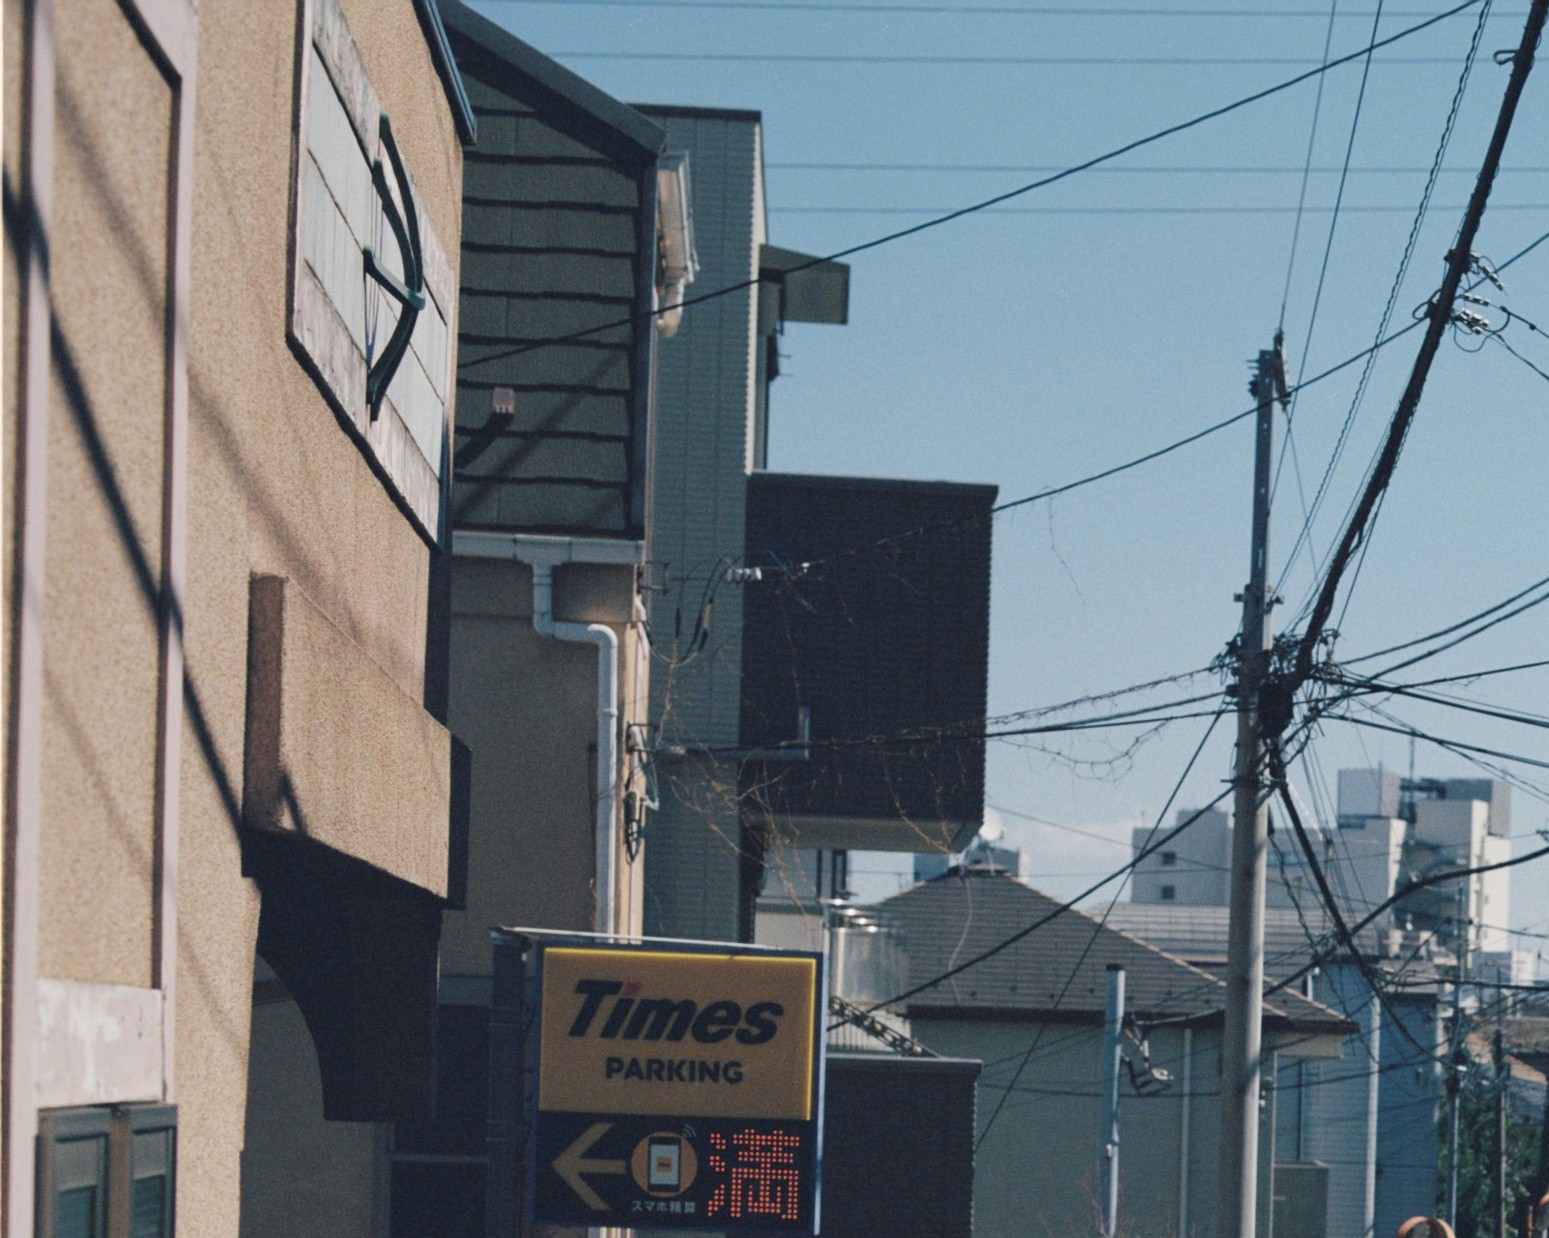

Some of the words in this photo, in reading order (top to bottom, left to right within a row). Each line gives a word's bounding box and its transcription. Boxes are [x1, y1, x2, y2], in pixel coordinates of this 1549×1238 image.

[568, 978, 785, 1045] Times
[605, 1056, 744, 1085] PARKING
[706, 1128, 801, 1221] 満
